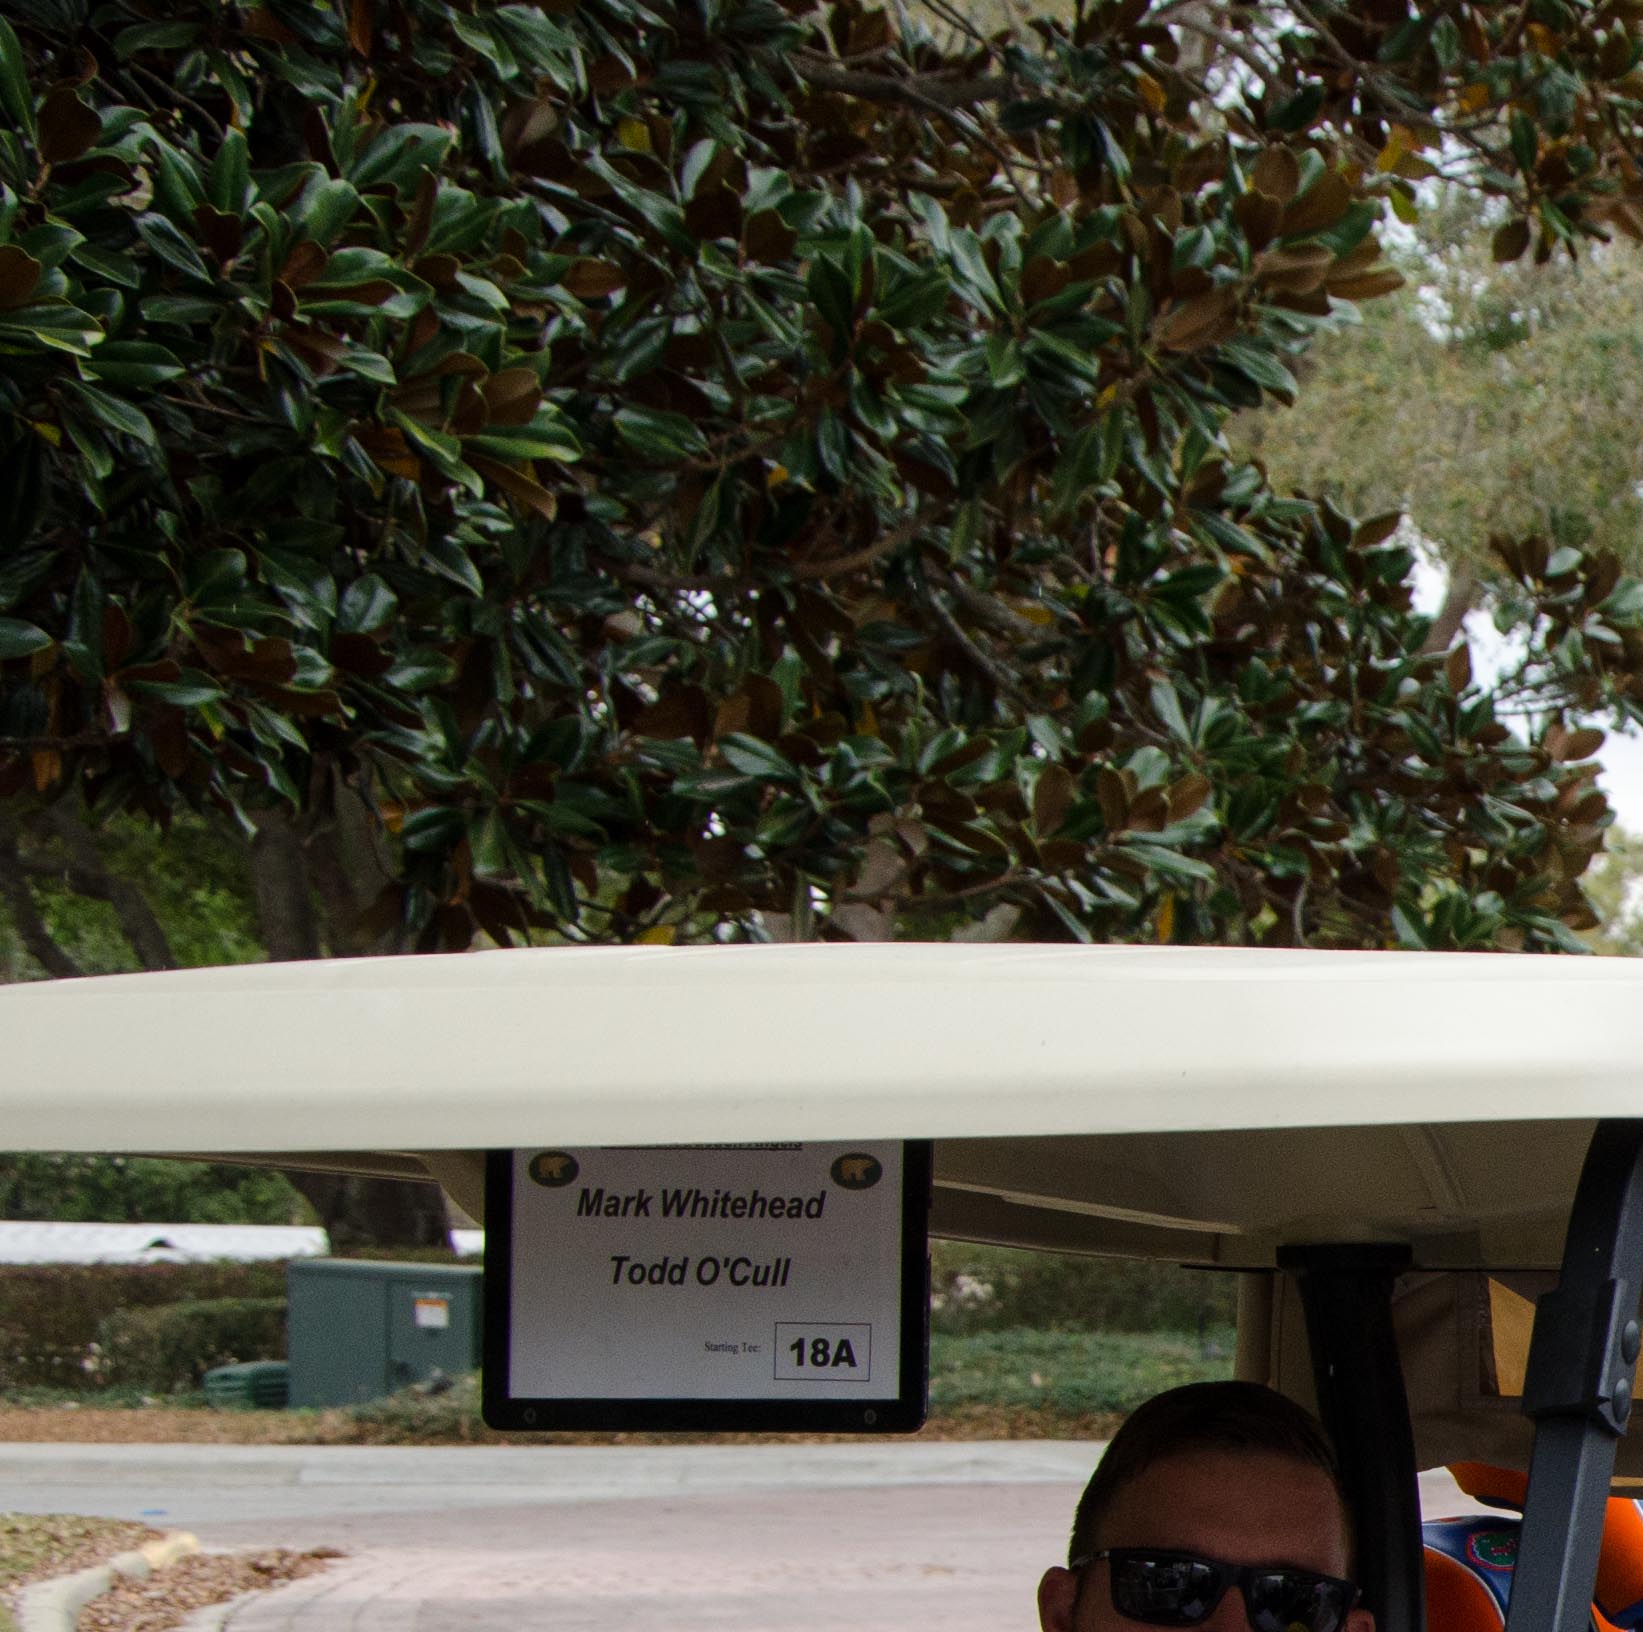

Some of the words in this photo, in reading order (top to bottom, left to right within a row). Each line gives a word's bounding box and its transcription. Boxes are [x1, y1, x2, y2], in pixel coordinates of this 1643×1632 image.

[577, 1188, 651, 1217] Mark
[661, 1189, 826, 1220] Whitehead
[610, 1256, 690, 1286] Todd
[696, 1257, 791, 1287] O'Cull
[704, 1341, 739, 1355] Starting
[790, 1337, 858, 1368] 18A
